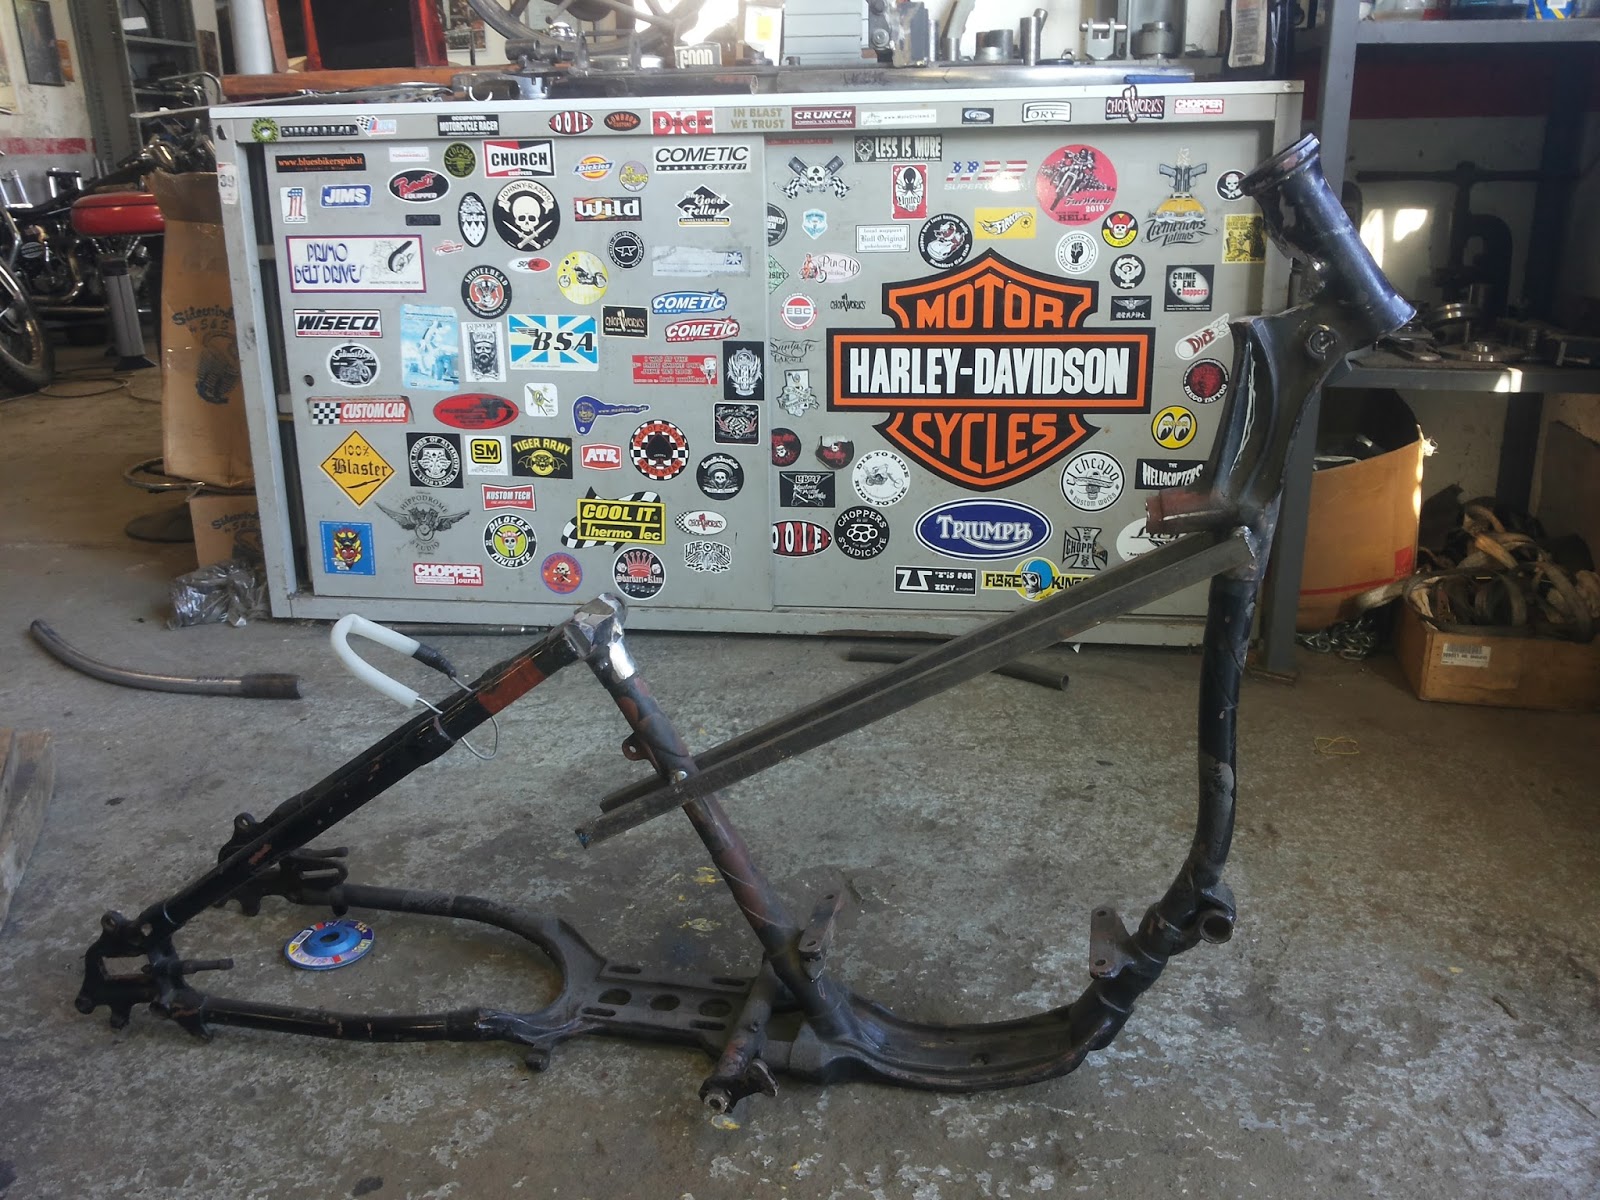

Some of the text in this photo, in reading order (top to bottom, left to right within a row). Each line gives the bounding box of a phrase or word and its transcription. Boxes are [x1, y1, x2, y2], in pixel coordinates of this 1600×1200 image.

[1175, 99, 1223, 108] CHOPPER
[733, 107, 782, 117] IN BLAST
[794, 111, 852, 119] CRUNCH
[439, 120, 498, 131] MOTORCYCLE RACER
[731, 119, 785, 128] WE TRUST
[655, 146, 749, 162] COMETIC
[874, 136, 941, 158] LESS IS MORE
[491, 152, 548, 166] CHURCH
[578, 162, 613, 172] Dickies
[705, 163, 747, 171] GASKET
[324, 188, 367, 204] JIMS
[577, 199, 640, 216] Wild
[1085, 205, 1104, 213] 2010
[1058, 213, 1091, 222] HELL
[465, 267, 508, 286] SHOVELHEAD
[1172, 271, 1197, 280] CRIME
[653, 297, 726, 310] COMETIC
[916, 272, 1064, 329] MOTOR
[786, 307, 812, 315] EBC
[297, 315, 379, 330] WISECO
[666, 322, 739, 338] COMETIC
[532, 330, 593, 351] BSA
[849, 347, 1130, 395] HARLEY-DAVIDSON
[1184, 383, 1227, 403] DIEGO TATTOO
[344, 444, 370, 457] 100%
[512, 438, 571, 456] TIGER ARMY
[912, 412, 1057, 474] CYCLES
[584, 448, 620, 463] ATR
[332, 457, 388, 476] Blaster
[856, 454, 873, 471] DIE
[890, 454, 910, 479] RIDE
[486, 491, 531, 500] KUSTOM TECH
[854, 479, 874, 504] RIDE
[890, 486, 908, 504] DIE
[400, 494, 448, 514] HIPPODROME
[582, 504, 656, 521] COOL IT
[837, 509, 887, 529] CHOPPERS
[585, 522, 661, 541] Thermo Tec
[936, 514, 1033, 547] TRIUMPH
[838, 537, 887, 557] SYNDICATE
[414, 564, 481, 577] CHOPPER
[957, 571, 973, 580] FOR
[985, 573, 1023, 588] FLAKE
